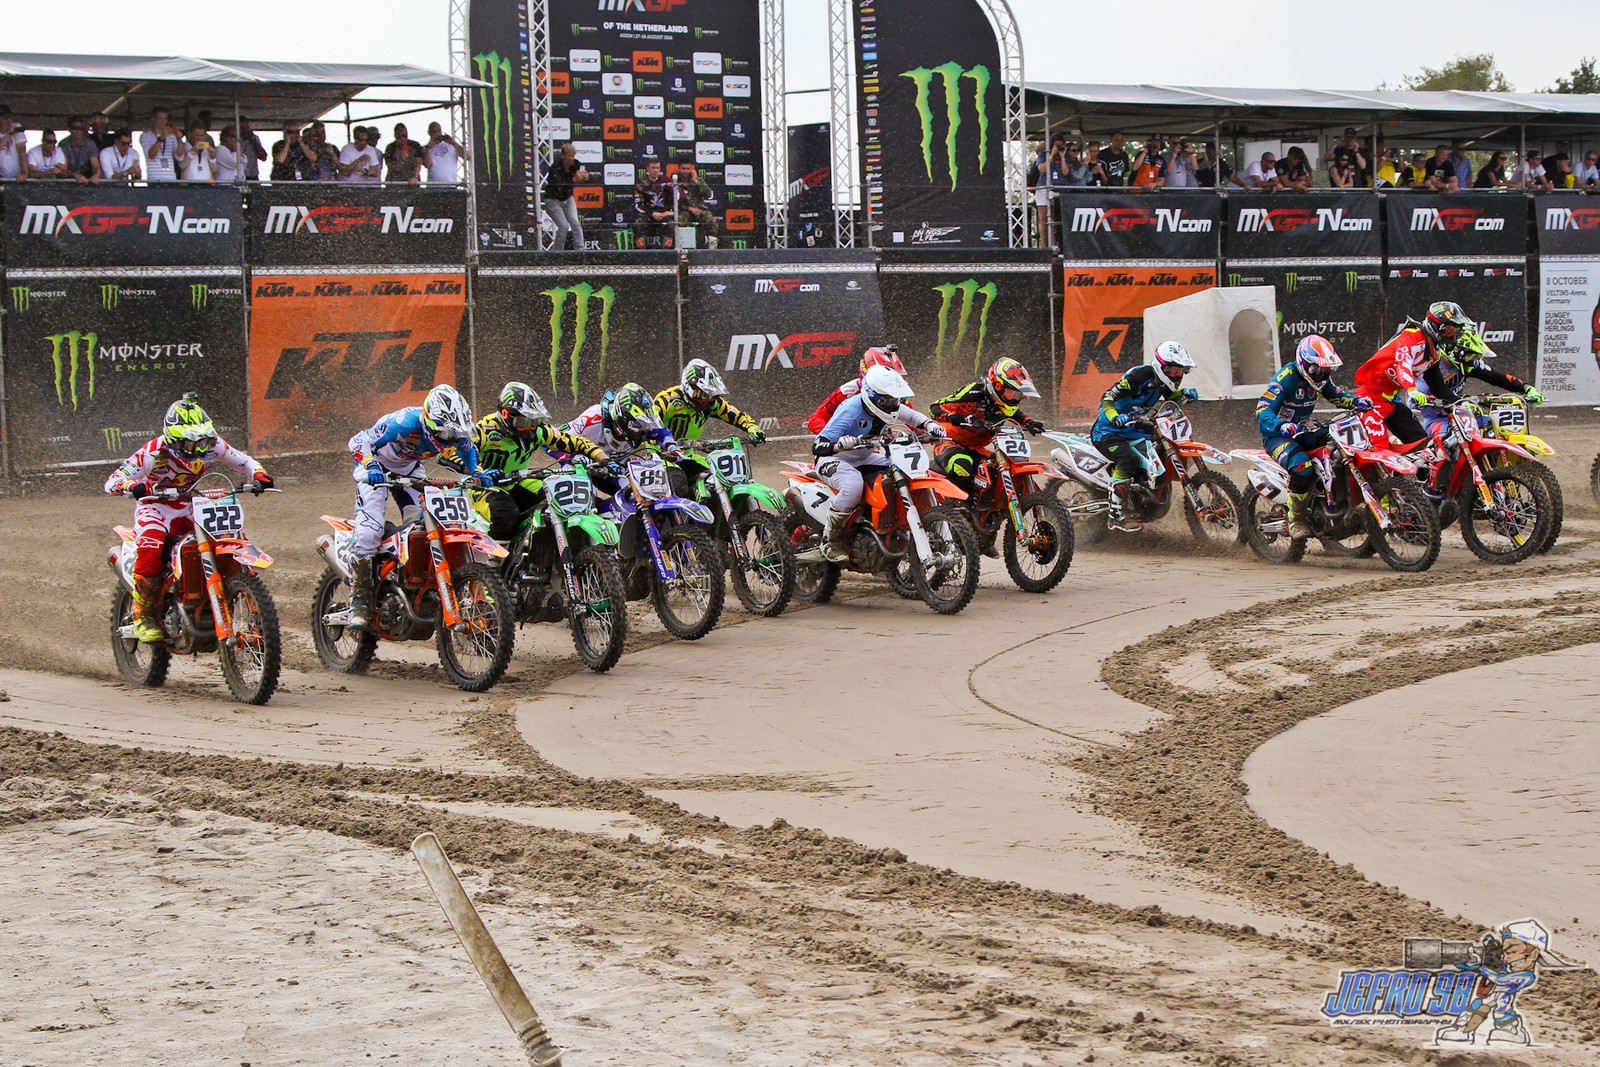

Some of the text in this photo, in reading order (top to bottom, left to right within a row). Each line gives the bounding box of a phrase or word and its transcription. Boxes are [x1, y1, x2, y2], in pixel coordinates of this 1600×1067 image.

[603, 22, 688, 33] OF THE NETHERLANDS
[637, 57, 659, 66] KTM
[698, 103, 719, 113] KTM
[608, 124, 630, 134] KTM
[577, 192, 600, 202] KTM
[730, 214, 751, 224] KTM
[1068, 274, 1094, 286] KTM
[1106, 273, 1134, 286] KTM
[1148, 273, 1178, 286] KTM
[1190, 272, 1214, 286] KTM
[1546, 277, 1588, 286] 8 OCTOBER
[118, 288, 157, 296] MONSTER
[255, 282, 295, 298] KTM
[313, 281, 352, 297] KTM
[371, 281, 408, 296] KTM
[424, 280, 462, 295] KTM
[1283, 320, 1357, 336] MONSTER
[100, 342, 204, 362] MONSTER
[725, 331, 857, 374] MXGP
[1072, 317, 1144, 375] KT
[115, 362, 188, 372] ENERGY
[264, 330, 443, 399] KTM
[1498, 411, 1525, 426] 22
[1168, 419, 1190, 441] 17
[1337, 423, 1366, 446] 77
[1005, 440, 1028, 455] 24
[717, 454, 747, 477] 911
[904, 452, 921, 471] 7
[1076, 455, 1101, 471] 17
[639, 469, 666, 487] 89
[554, 480, 590, 506] 25
[811, 491, 829, 509] 7
[432, 497, 469, 522] 259
[202, 505, 241, 533] 222
[732, 530, 744, 557] DUNLOP
[565, 568, 576, 601] DUNLOP
